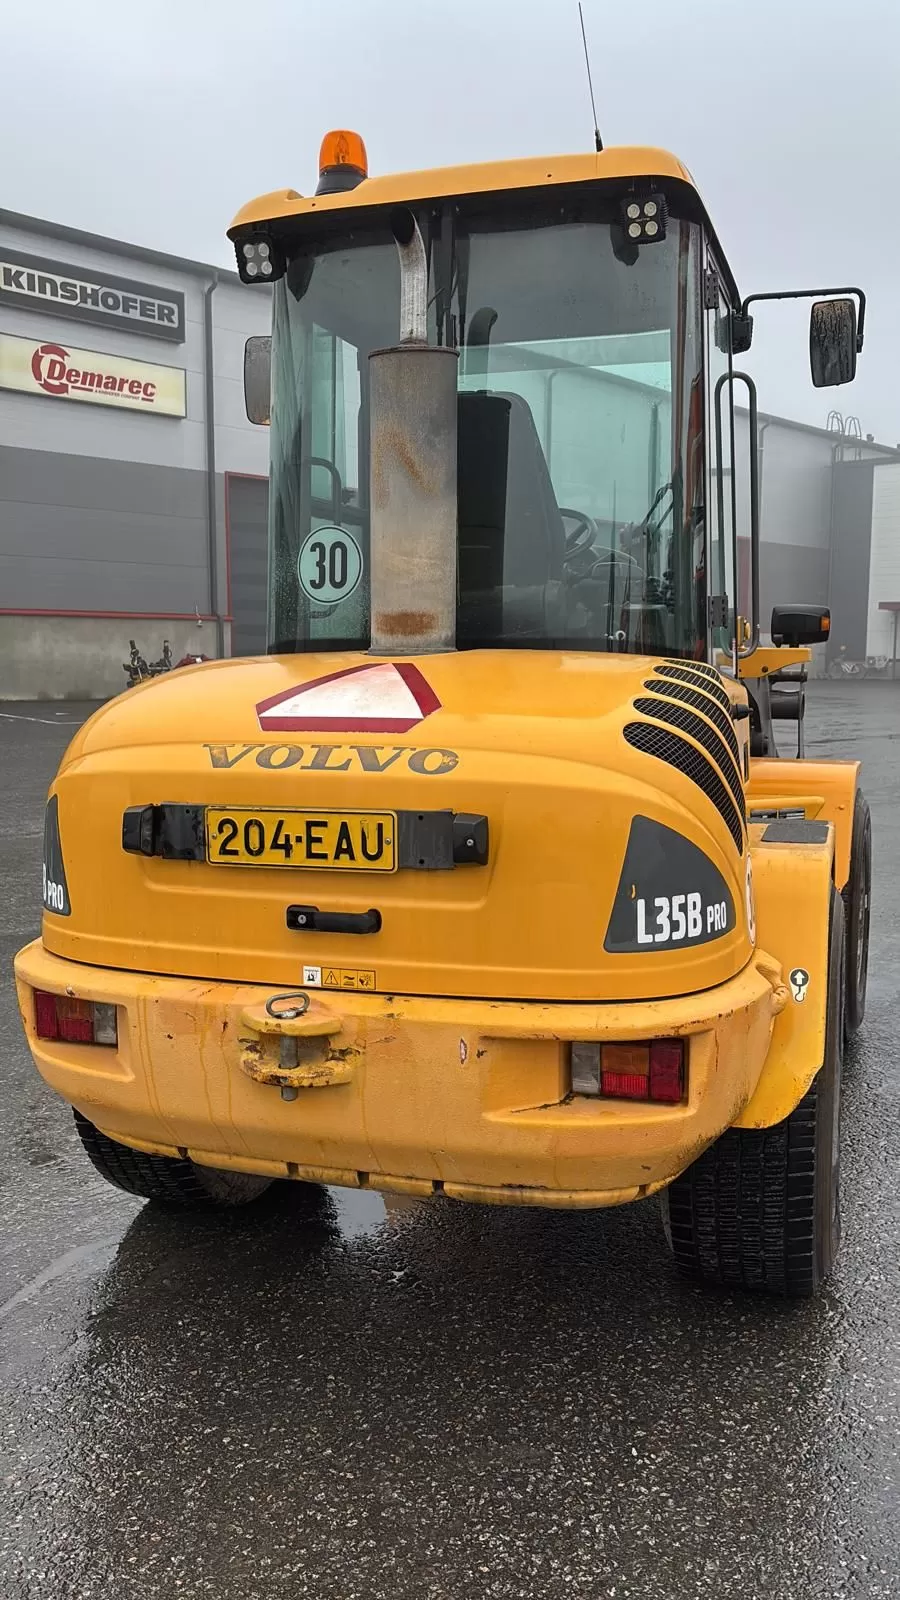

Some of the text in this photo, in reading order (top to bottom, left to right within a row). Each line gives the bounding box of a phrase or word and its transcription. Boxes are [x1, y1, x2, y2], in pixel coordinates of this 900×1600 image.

[3, 267, 176, 324] KINSHOFER
[47, 359, 157, 397] Demarec
[309, 541, 348, 590] 30
[202, 744, 459, 775] VOLVO
[47, 880, 64, 910] PRO
[637, 892, 727, 944] L35B PRO
